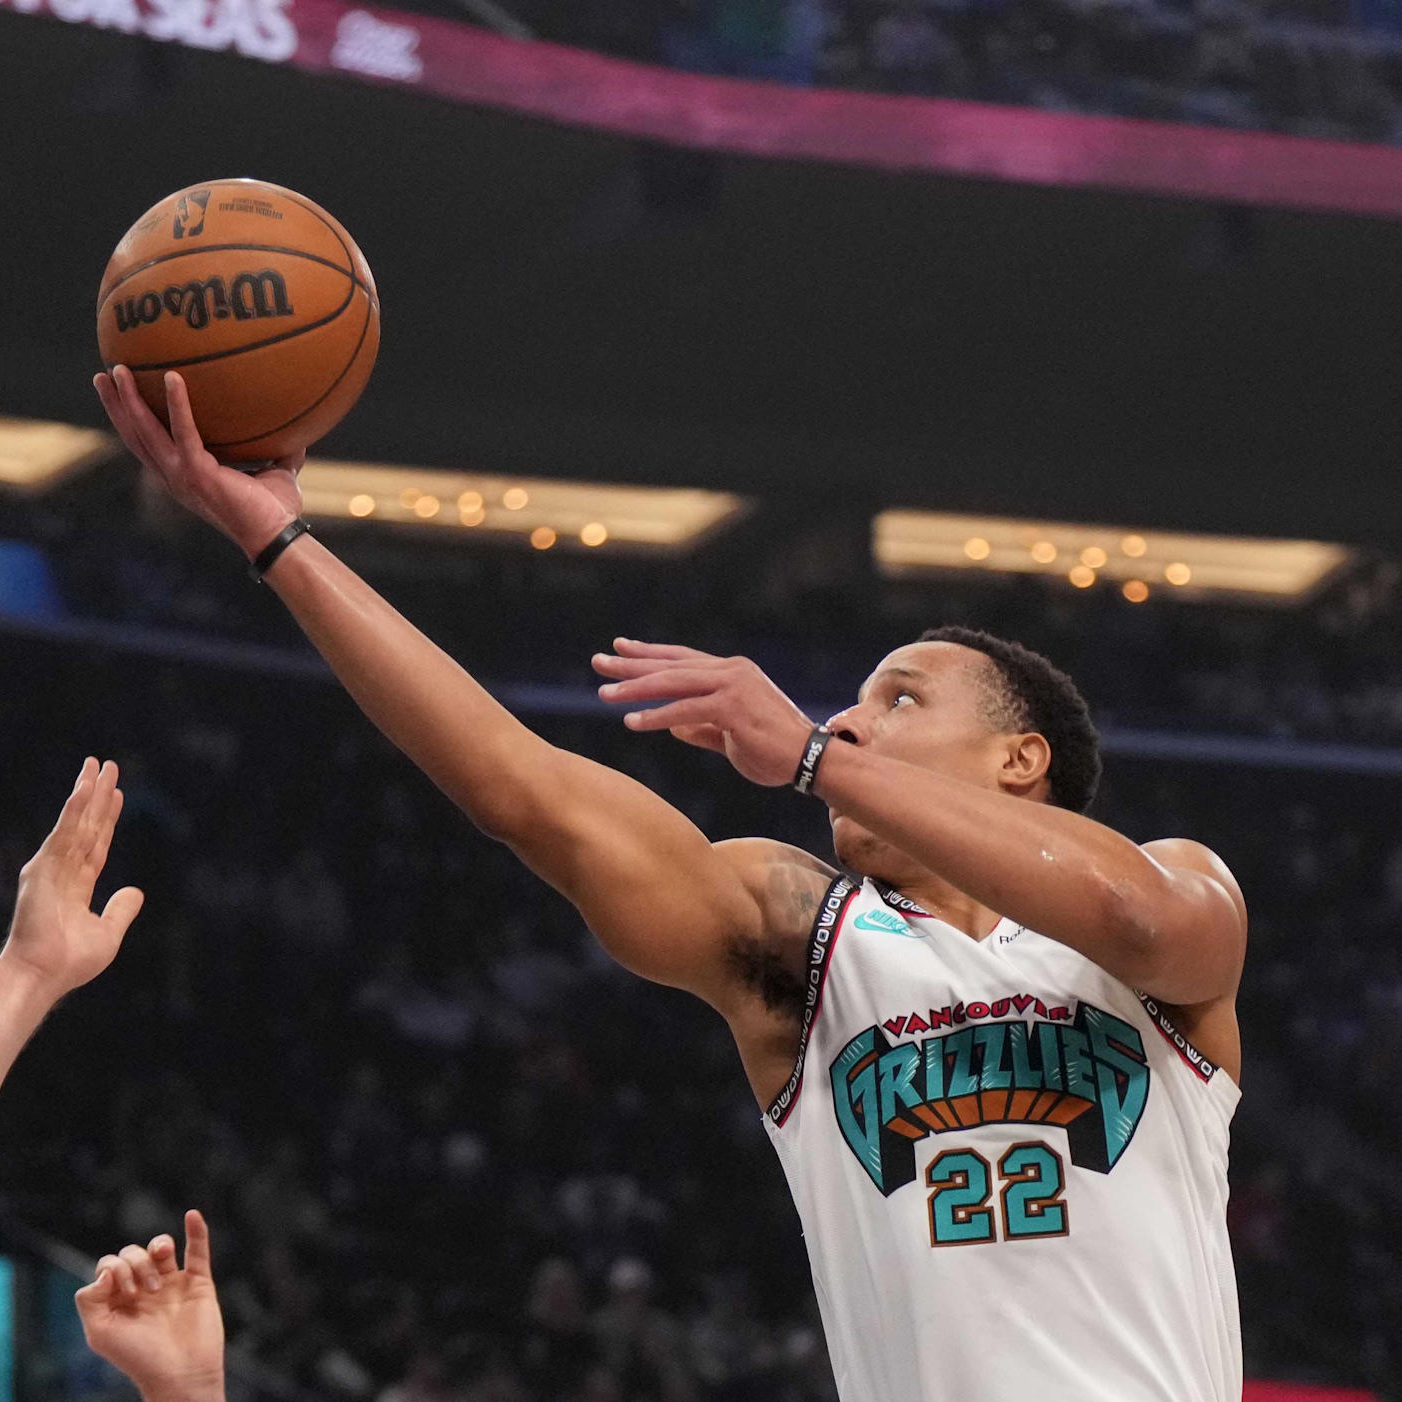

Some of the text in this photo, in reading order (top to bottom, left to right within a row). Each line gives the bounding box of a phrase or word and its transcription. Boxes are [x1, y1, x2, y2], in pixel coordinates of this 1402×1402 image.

[114, 269, 294, 332] Wilson
[829, 999, 1150, 1198] GRIZZLIES
[925, 1140, 1069, 1248] 22
